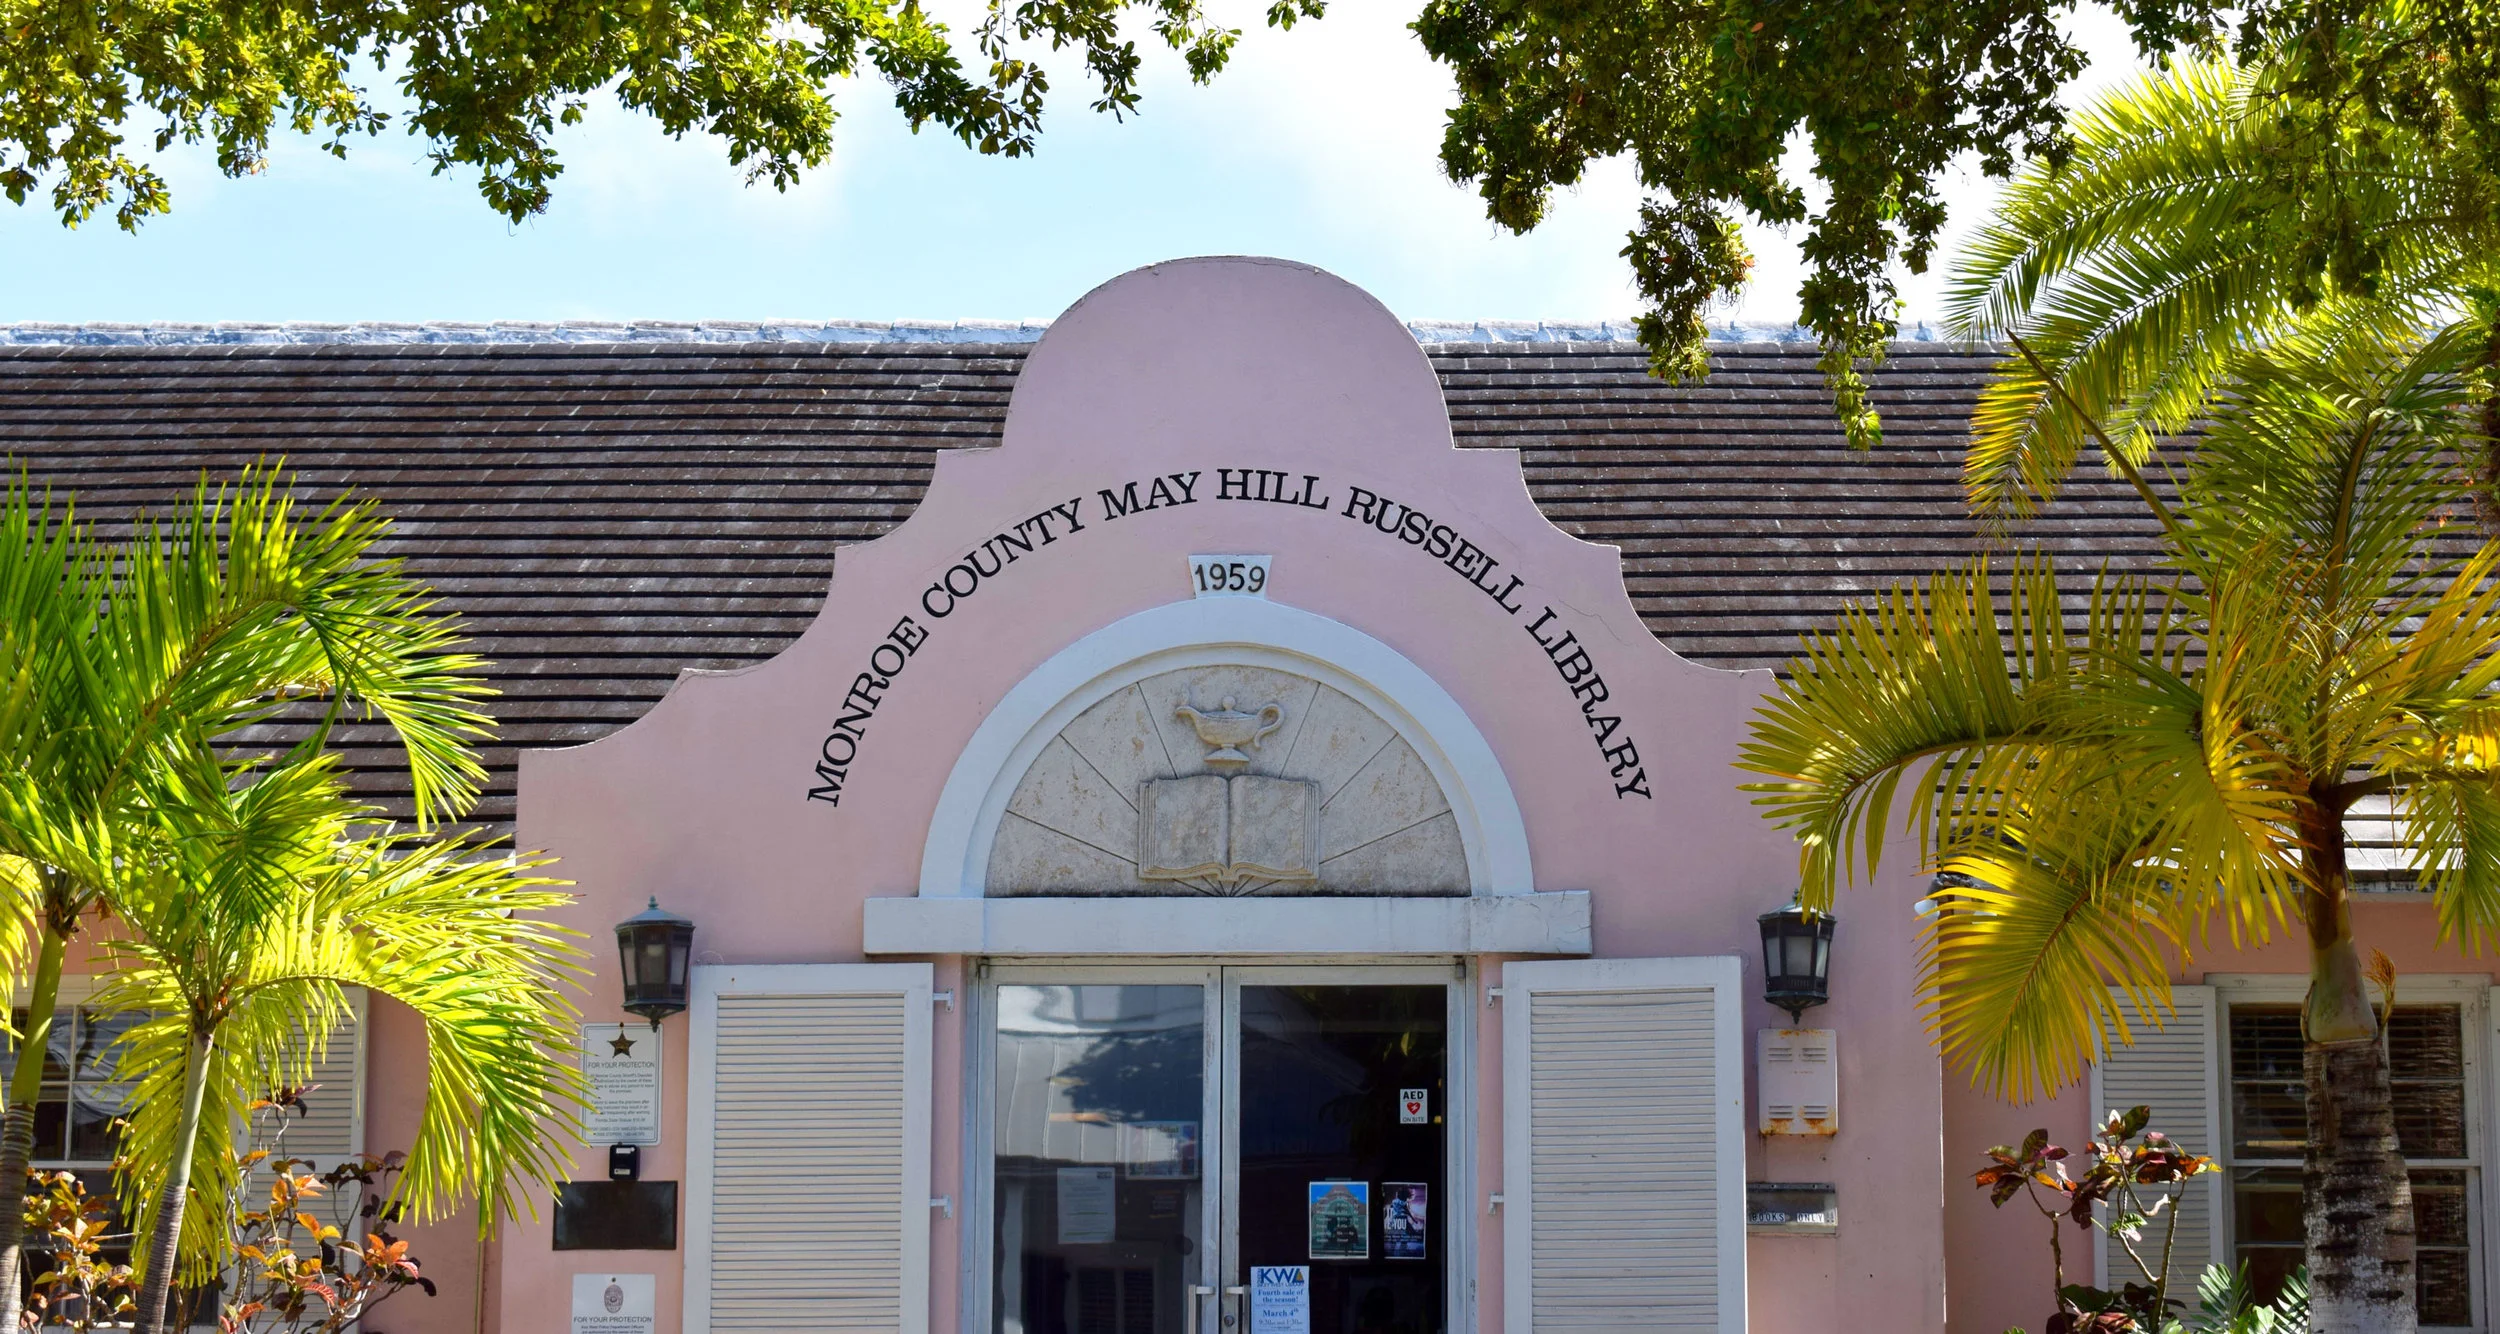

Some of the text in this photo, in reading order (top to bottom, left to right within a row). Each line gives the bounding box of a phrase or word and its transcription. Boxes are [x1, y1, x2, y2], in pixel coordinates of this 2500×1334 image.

[1195, 563, 1266, 593] 1959
[806, 468, 1652, 808] MONROE COUNTY MAY HILL RUSSELL LIBRARY
[1403, 1091, 1424, 1100] AED
[1262, 1309, 1288, 1317] March
